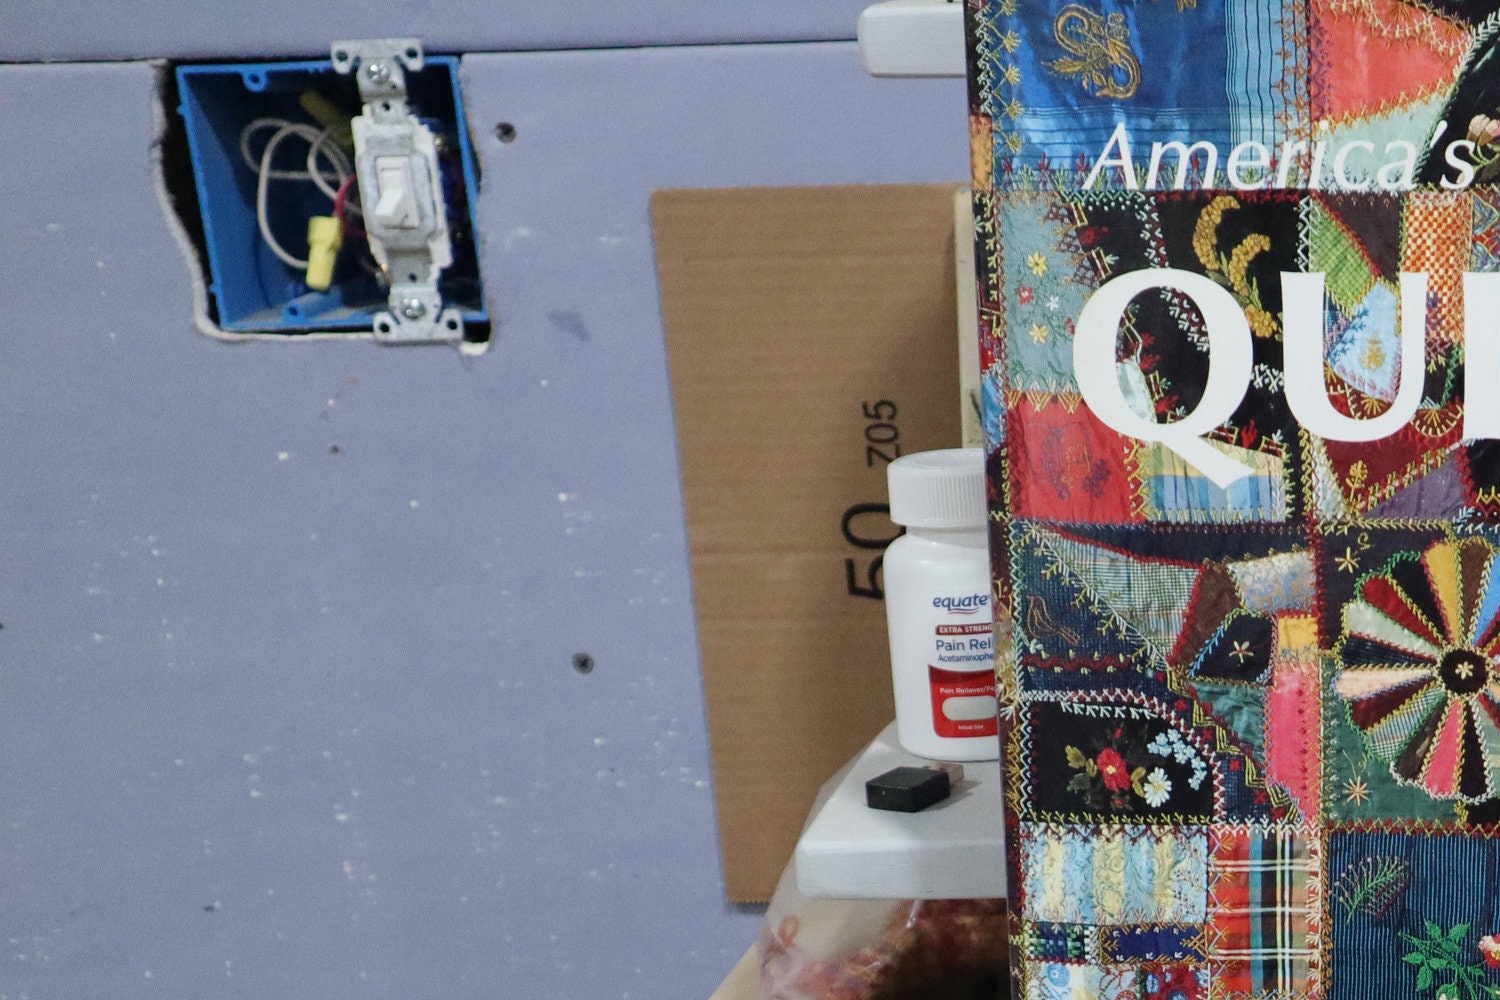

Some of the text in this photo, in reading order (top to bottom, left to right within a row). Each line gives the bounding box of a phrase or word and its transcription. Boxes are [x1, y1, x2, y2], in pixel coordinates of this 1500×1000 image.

[1082, 118, 1474, 191] America's
[932, 593, 988, 611] equate
[938, 625, 963, 634] EXTRA
[936, 639, 965, 652] Pain
